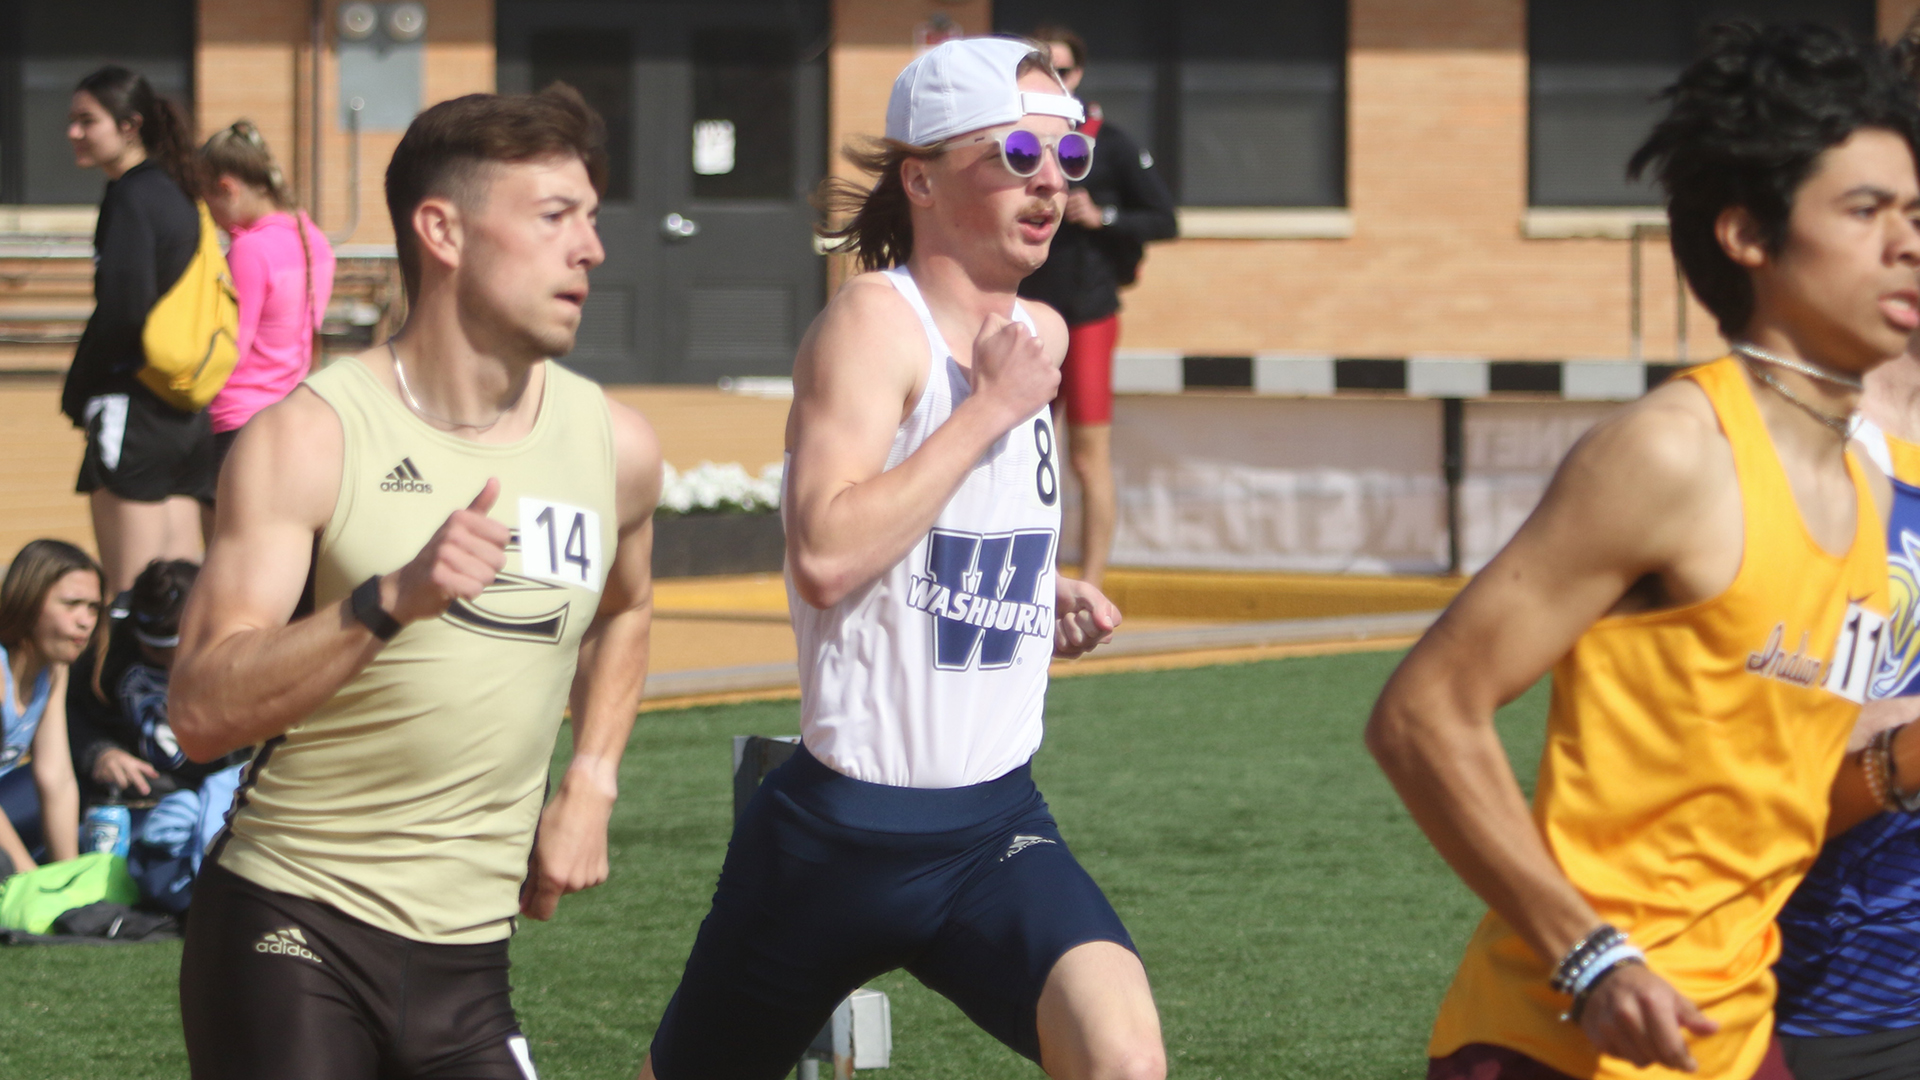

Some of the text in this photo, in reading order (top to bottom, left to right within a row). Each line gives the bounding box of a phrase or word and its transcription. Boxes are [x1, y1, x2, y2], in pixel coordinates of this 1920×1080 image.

[380, 479, 433, 494] adidas
[1034, 418, 1057, 506] 8
[535, 506, 591, 582] 14
[907, 575, 1052, 638] WASHBURN
[1841, 612, 1884, 700] 11
